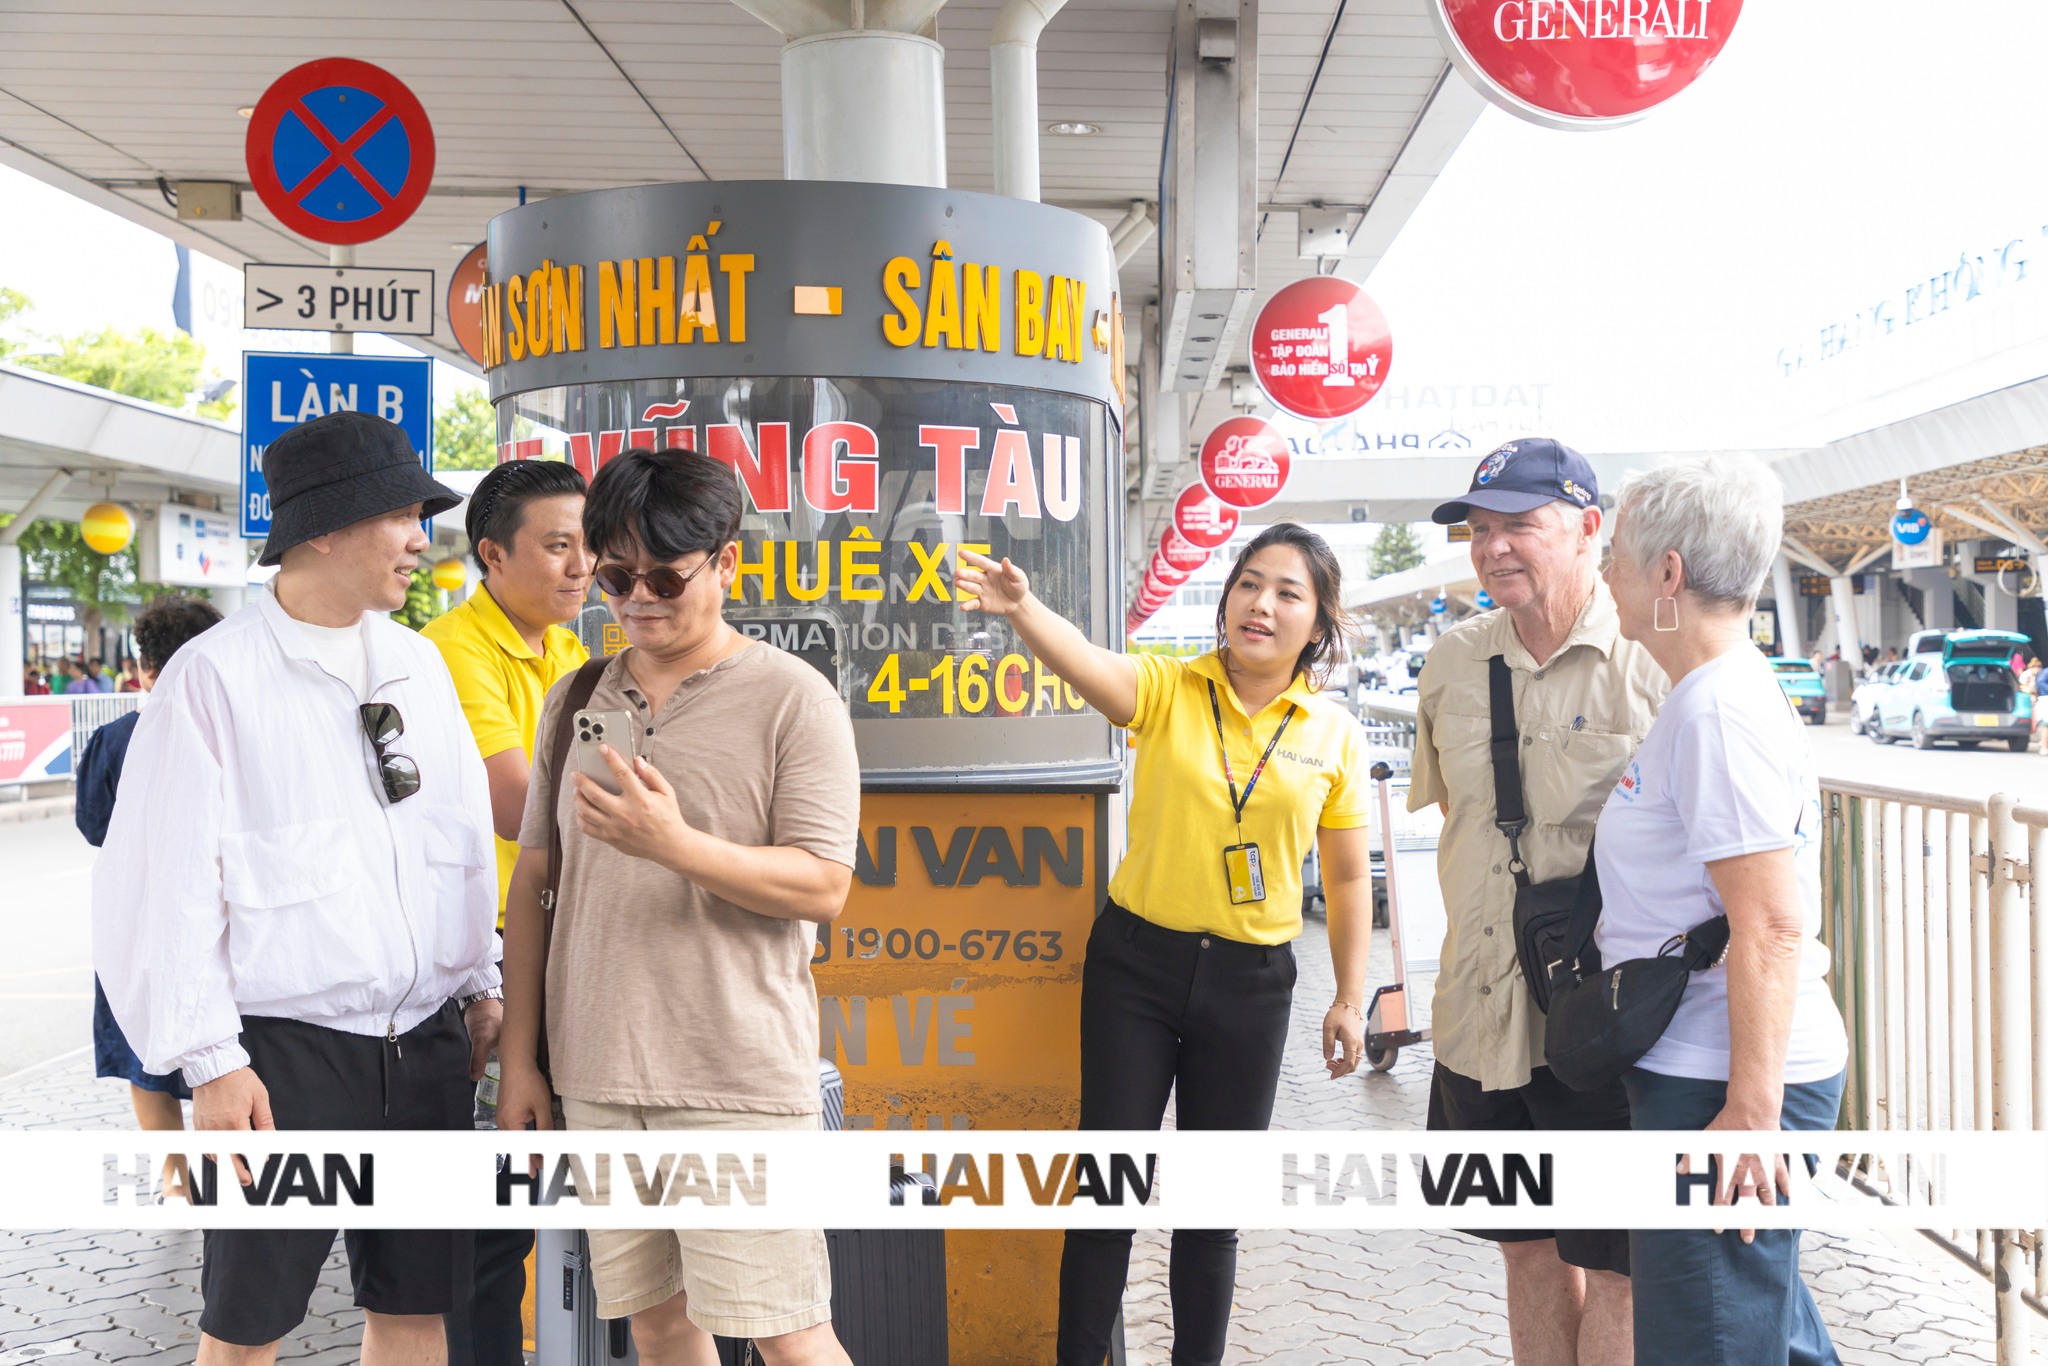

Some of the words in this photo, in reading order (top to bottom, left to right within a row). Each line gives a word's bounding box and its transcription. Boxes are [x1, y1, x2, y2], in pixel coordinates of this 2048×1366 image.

[1493, 0, 1709, 42] GENERALI
[298, 285, 316, 318] 3
[330, 279, 420, 322] PHÚT
[481, 272, 505, 374] ÂN
[508, 259, 585, 361] SƠN
[598, 221, 755, 349] NHẤT
[882, 240, 999, 352] SÂN
[1014, 268, 1086, 363] BAY
[1271, 327, 1328, 341] GENERALI
[1271, 344, 1293, 360] TẬP
[1296, 344, 1328, 358] ĐOÀN
[272, 368, 357, 422] LÀN
[377, 384, 404, 425] B
[1384, 383, 1551, 410] HATDAT
[919, 402, 1081, 522] TÀU
[1215, 474, 1278, 488] GENERALI
[248, 489, 273, 522] ĐÓ
[1896, 523, 1920, 534] VIB
[730, 526, 883, 601] HUÊ
[905, 541, 991, 602] XE
[731, 622, 918, 651] RMATION
[1276, 748, 1297, 762] HAI
[1299, 754, 1324, 768] VAN
[911, 826, 1084, 887] VAN
[840, 927, 1064, 962] 1900-6763
[891, 977, 976, 1066] VÉ
